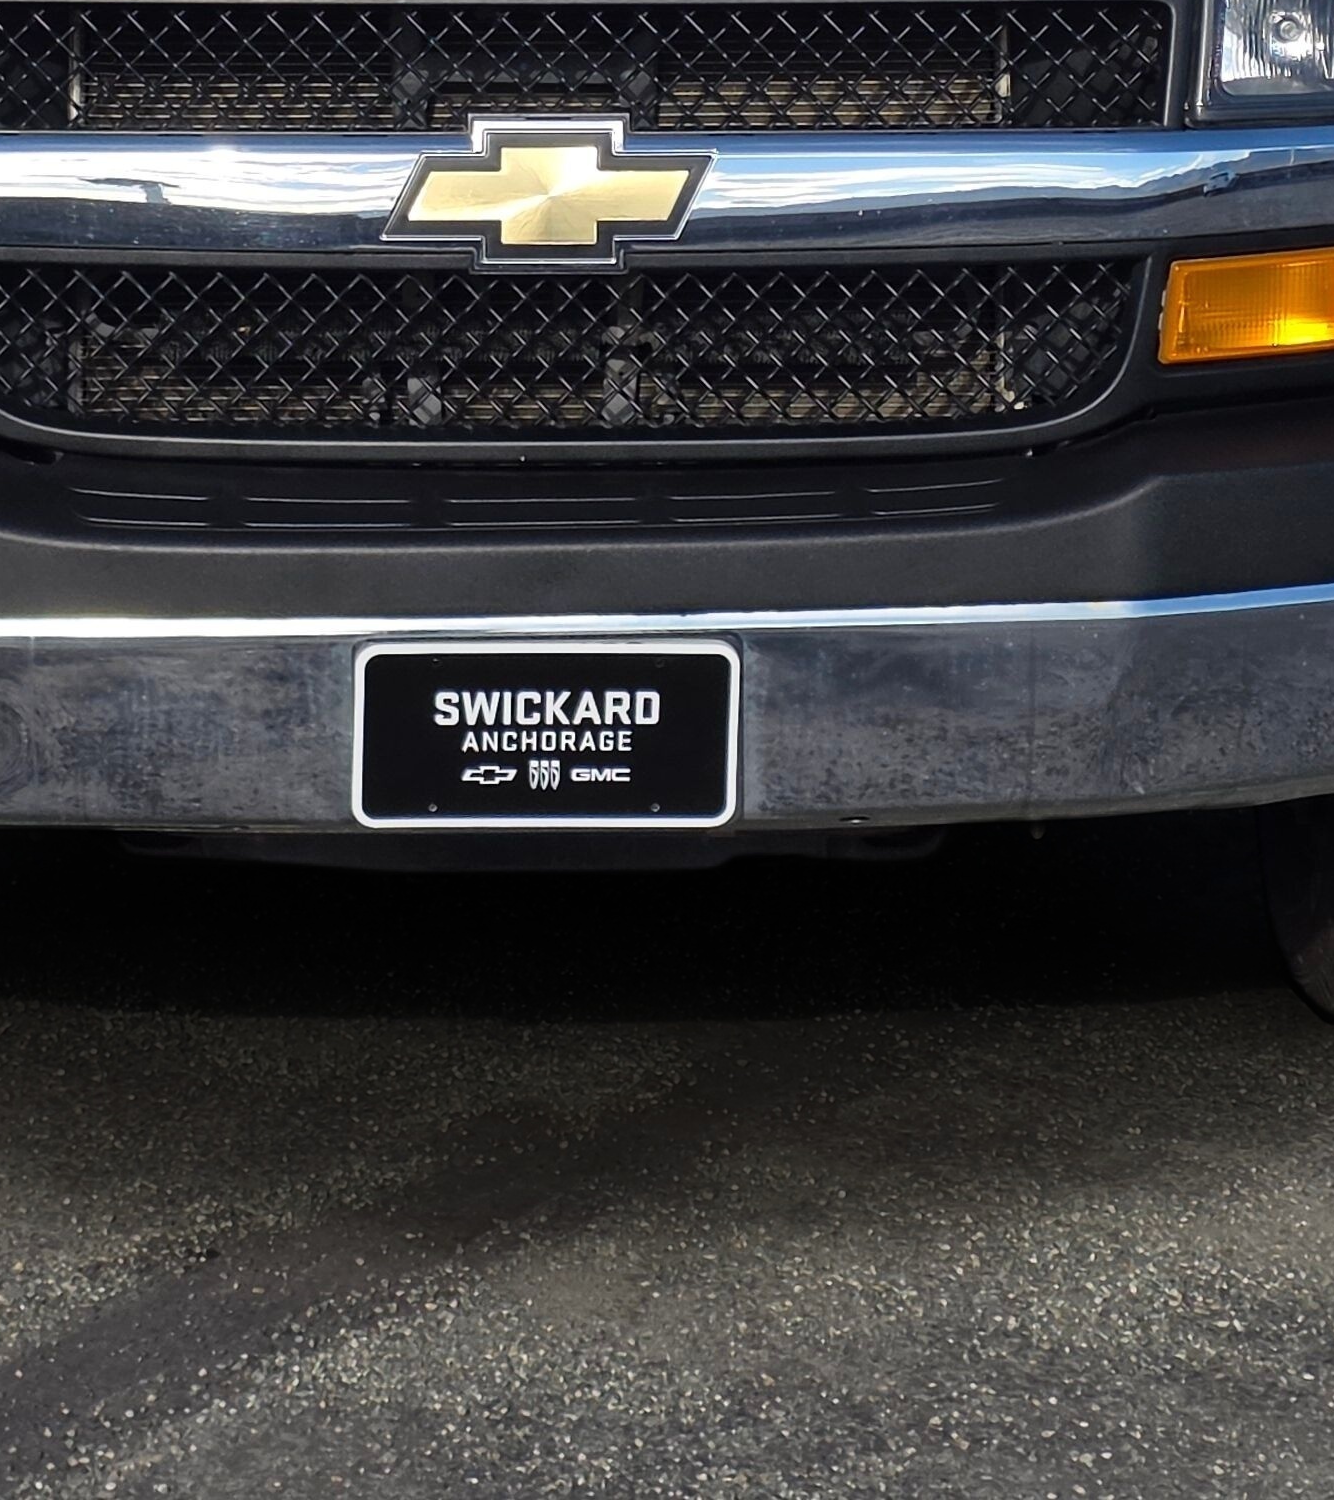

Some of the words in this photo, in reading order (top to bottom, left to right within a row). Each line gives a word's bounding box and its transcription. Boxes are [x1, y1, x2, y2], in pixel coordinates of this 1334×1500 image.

[434, 691, 660, 725] SWICKARD
[462, 731, 632, 752] ANCHORAGE
[571, 768, 631, 781] GMC
